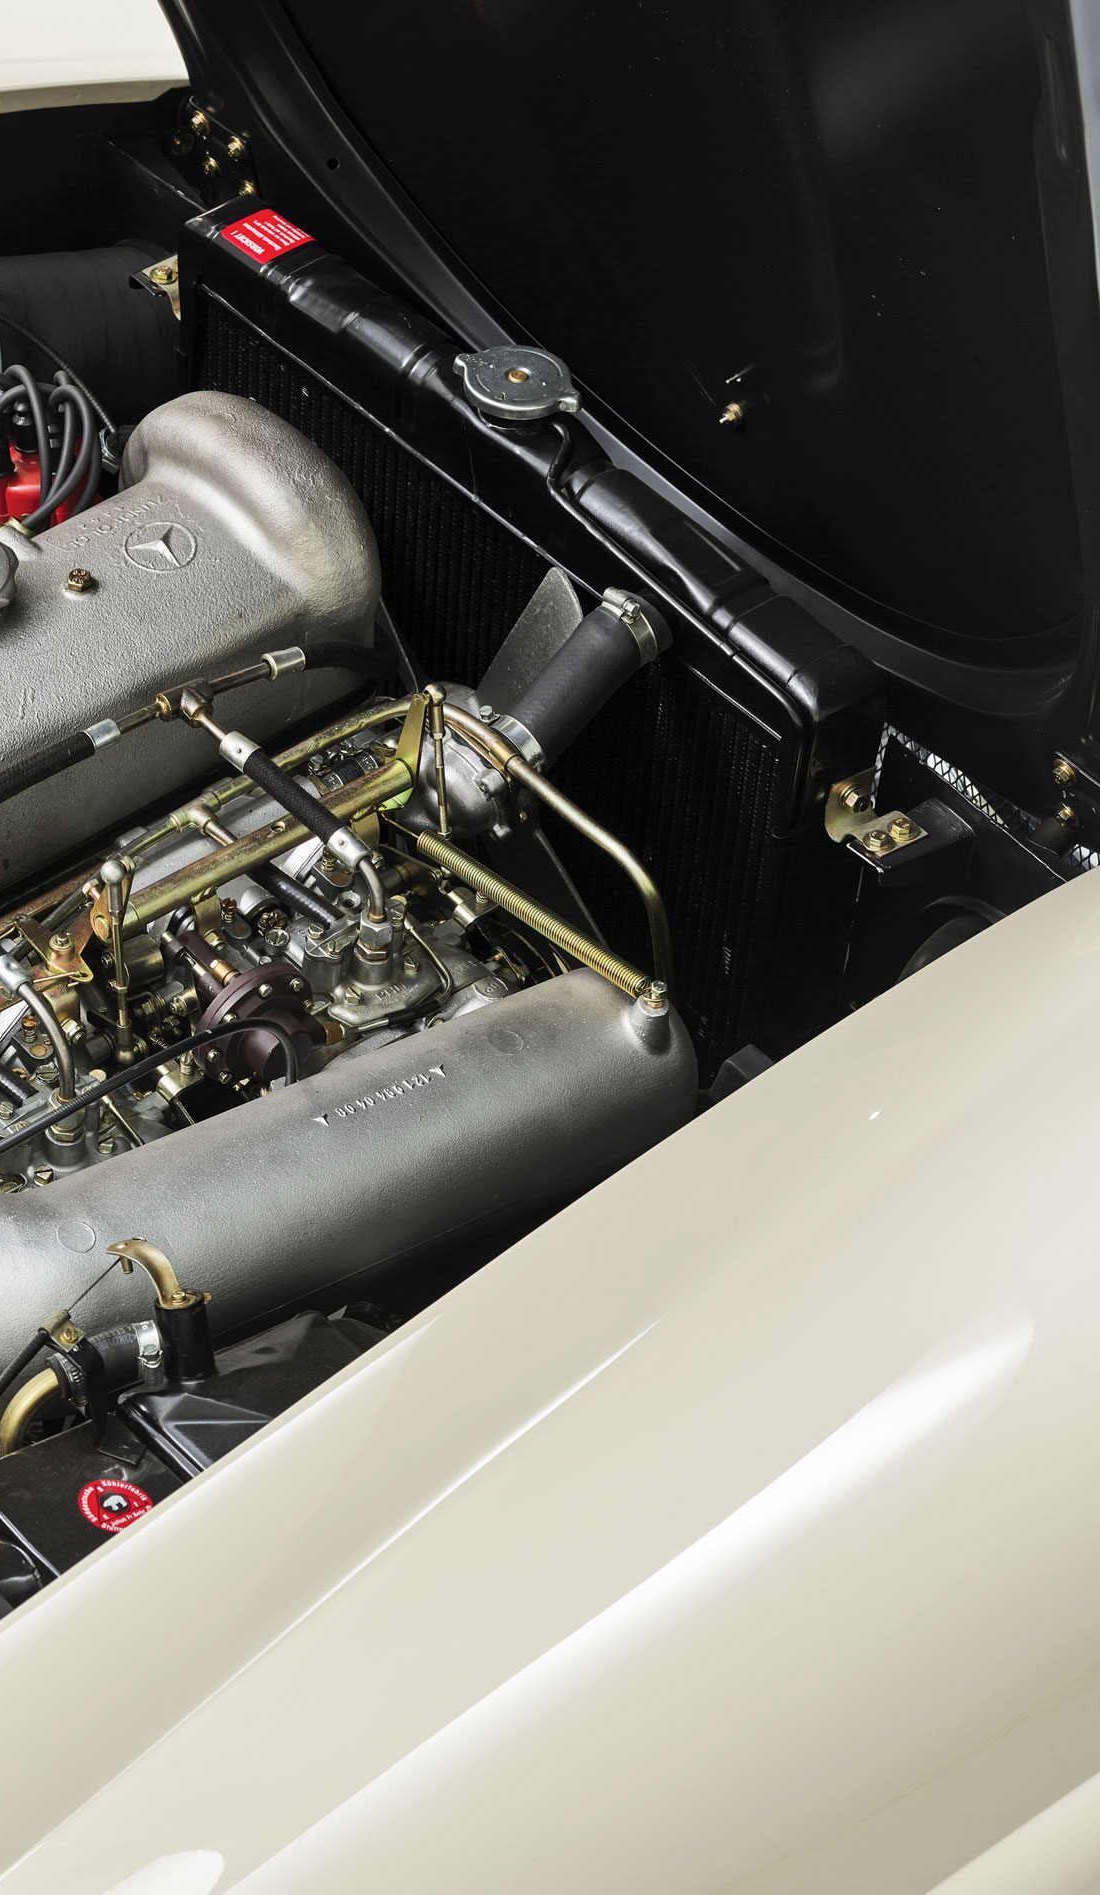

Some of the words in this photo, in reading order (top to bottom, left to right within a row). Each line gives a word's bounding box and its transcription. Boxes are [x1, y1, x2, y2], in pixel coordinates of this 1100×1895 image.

[233, 231, 264, 255] VORSICHT
[402, 1071, 432, 1092] 121
[355, 1094, 375, 1111] 04
[101, 1480, 147, 1501] Kühlerfabrik
